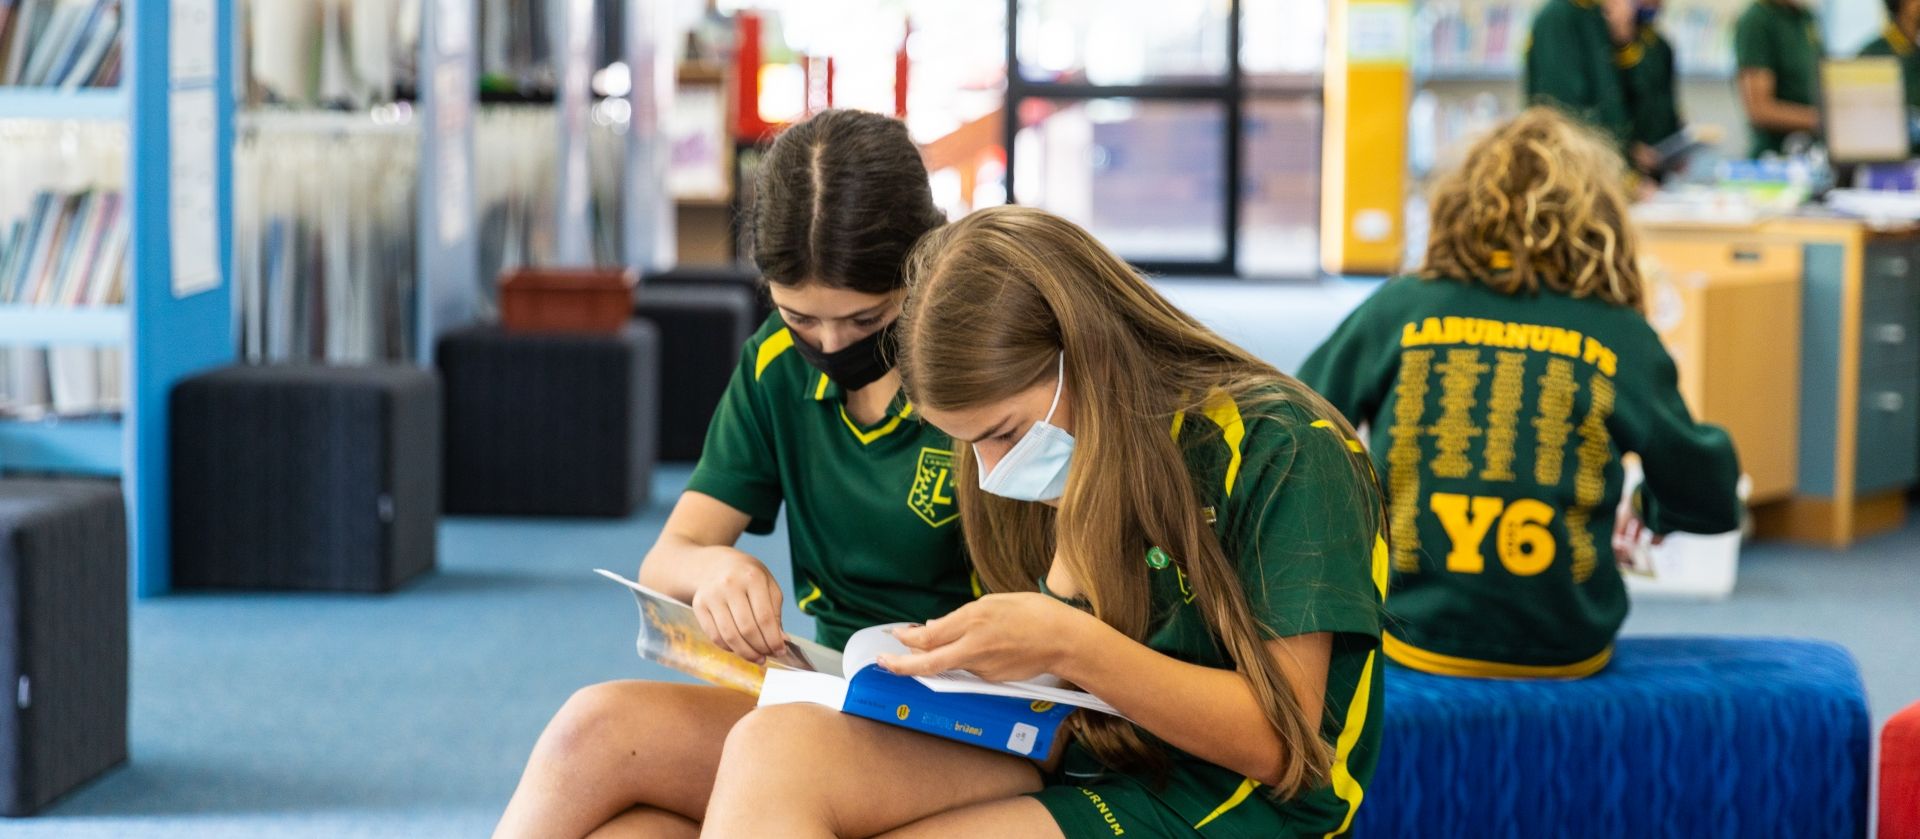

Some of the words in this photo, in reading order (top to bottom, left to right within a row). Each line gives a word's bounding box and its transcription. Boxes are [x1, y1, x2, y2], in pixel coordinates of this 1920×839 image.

[1401, 316, 1582, 357] LABURNUM
[1583, 336, 1618, 377] PS
[1430, 492, 1557, 577] Y6
[1077, 786, 1125, 836] URNUM
